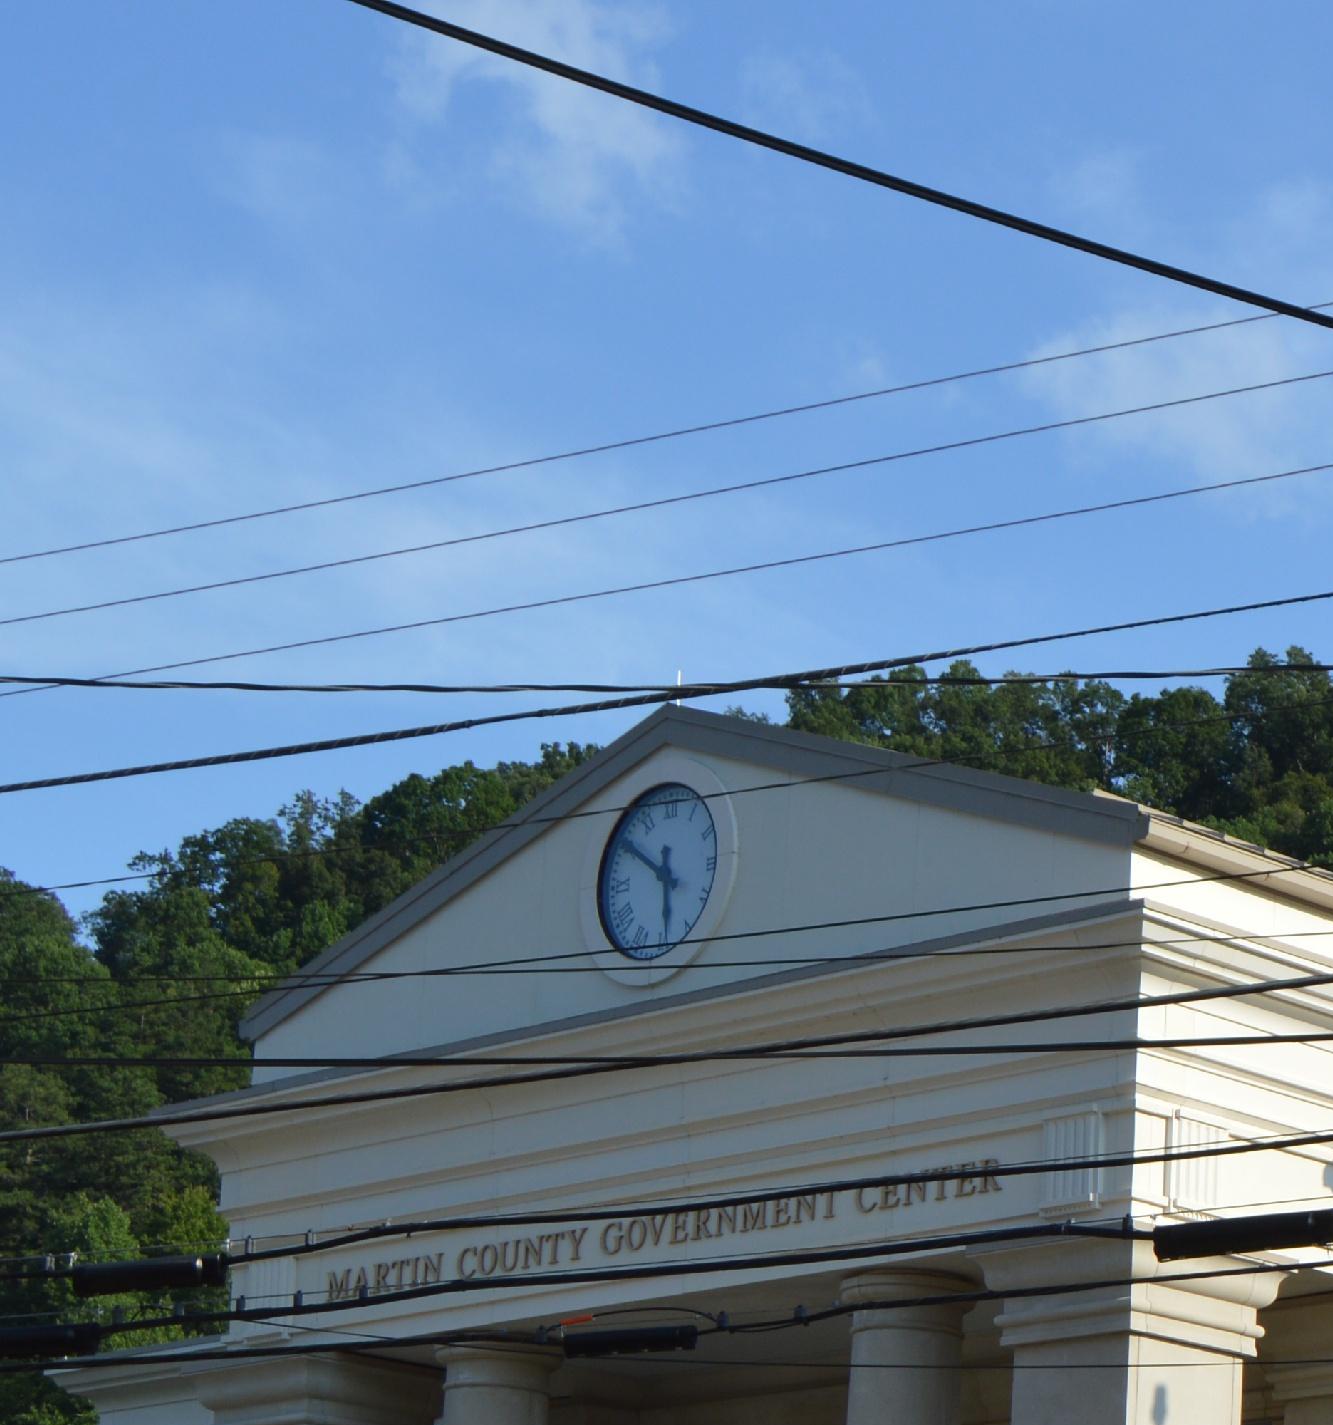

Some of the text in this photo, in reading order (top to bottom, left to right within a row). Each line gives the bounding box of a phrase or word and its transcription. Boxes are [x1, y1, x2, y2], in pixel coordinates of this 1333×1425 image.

[327, 1157, 1003, 1300] MARTIN COUNTY GOVERNMENT CENTER
